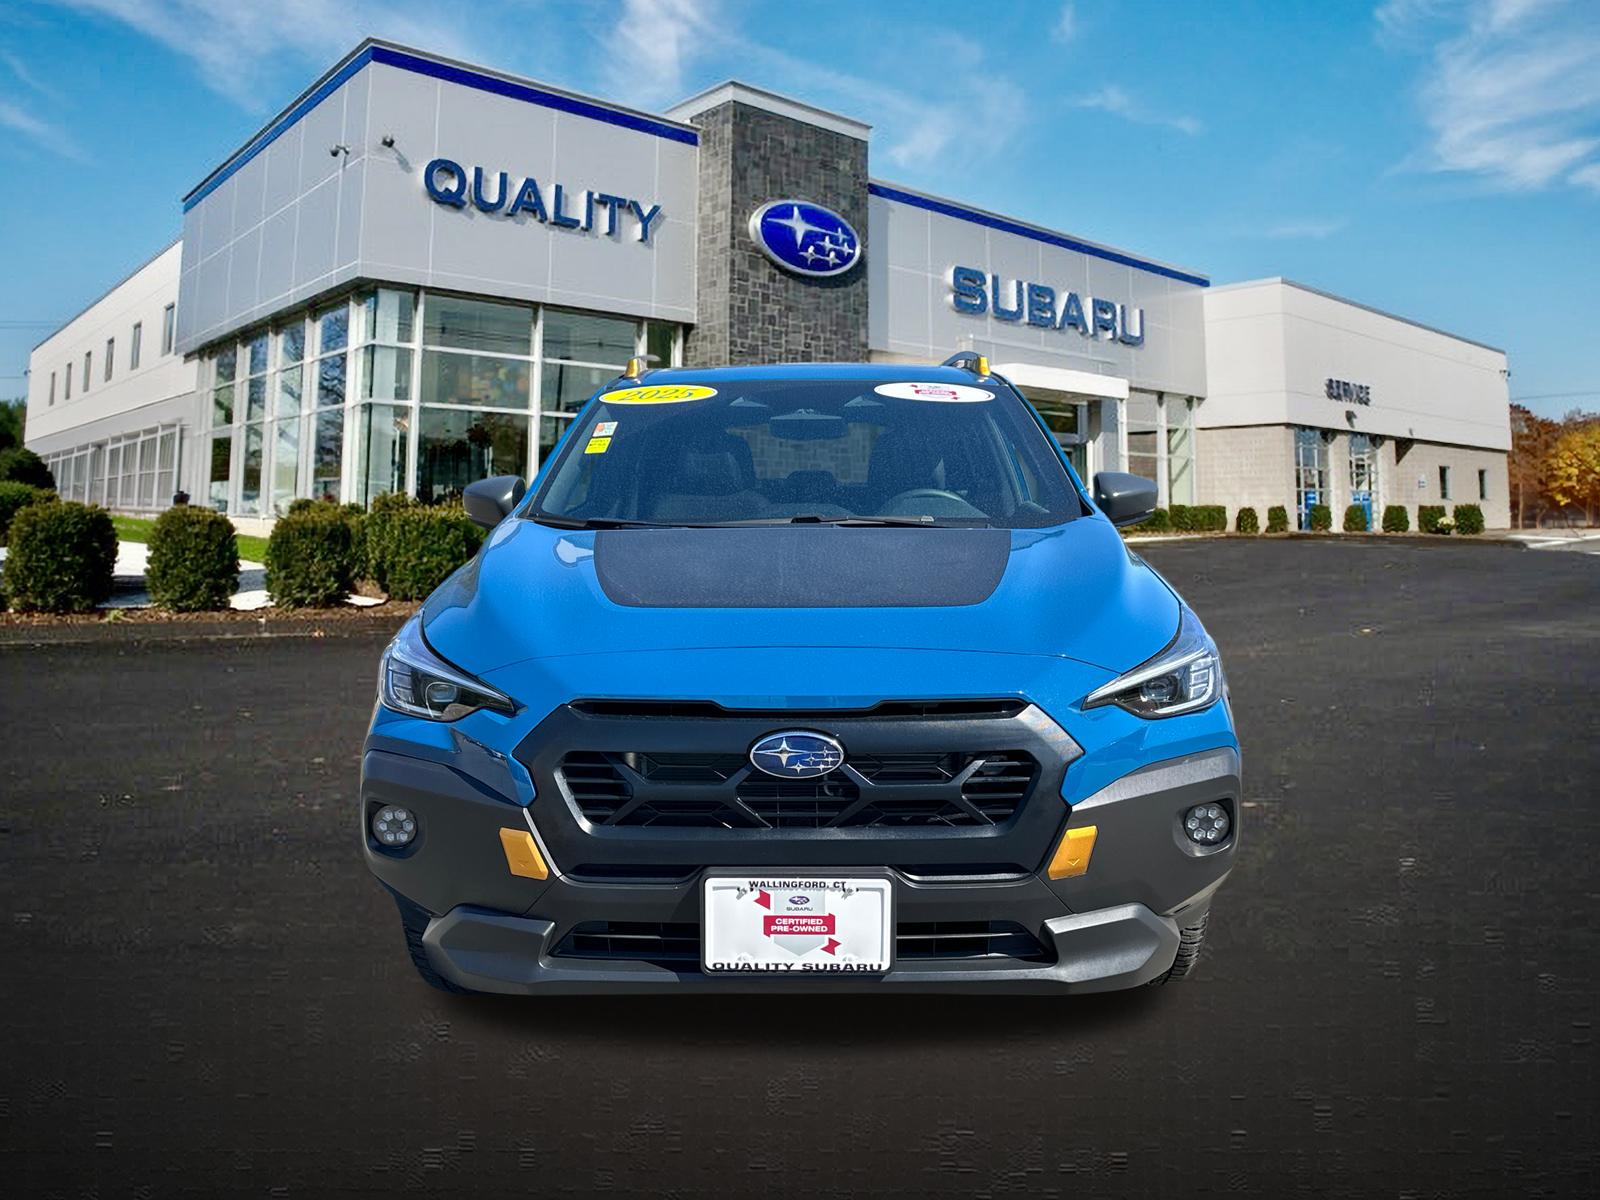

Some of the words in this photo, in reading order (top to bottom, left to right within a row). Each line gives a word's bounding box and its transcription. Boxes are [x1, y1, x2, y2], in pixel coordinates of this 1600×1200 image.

[424, 158, 661, 242] QUALITY
[948, 265, 1145, 346] SUBARU
[618, 388, 699, 401] 2025
[1325, 378, 1370, 406] SERVICE
[833, 880, 847, 890] CT
[712, 962, 795, 971] QUALITY
[802, 962, 882, 972] SUBARU
